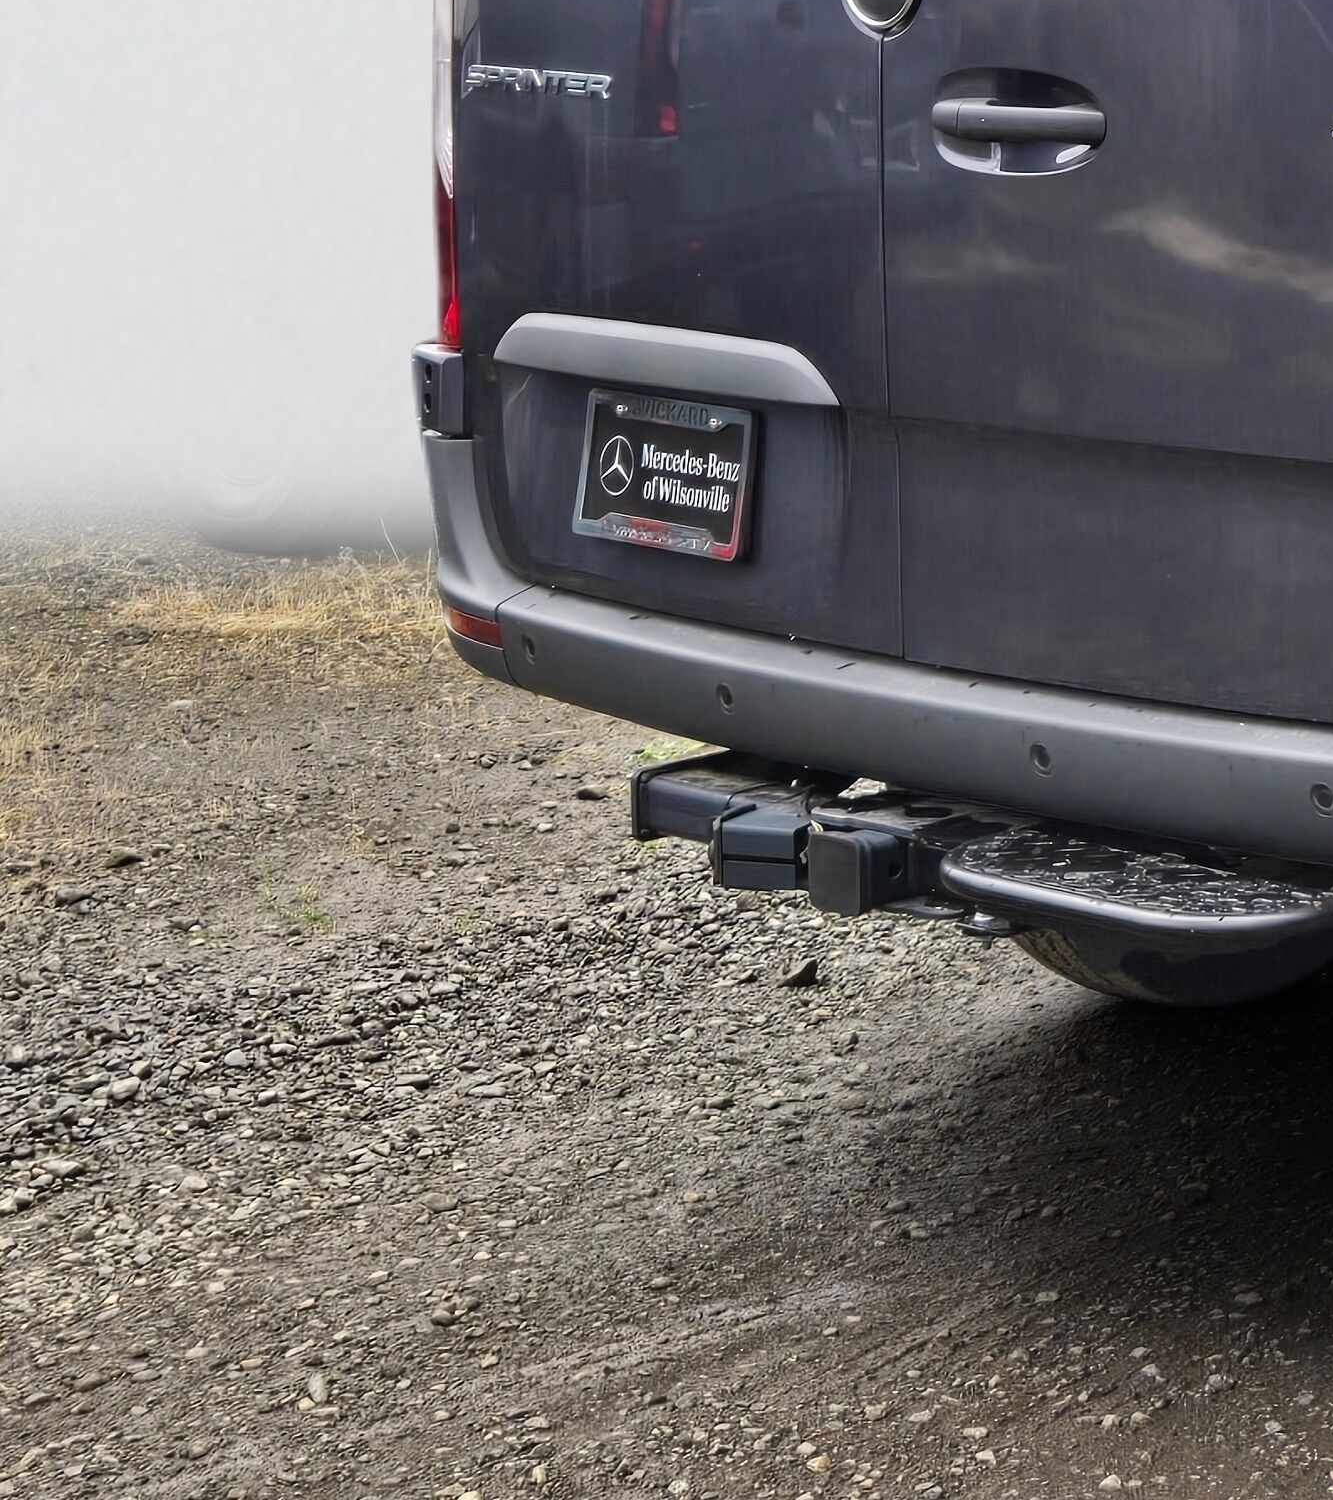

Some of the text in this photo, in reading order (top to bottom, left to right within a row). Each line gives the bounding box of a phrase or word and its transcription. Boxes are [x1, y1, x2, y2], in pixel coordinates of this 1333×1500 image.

[464, 63, 613, 100] SPRINTER
[641, 443, 741, 482] Mercedes-Benz
[643, 476, 730, 513] of Wilsonville
